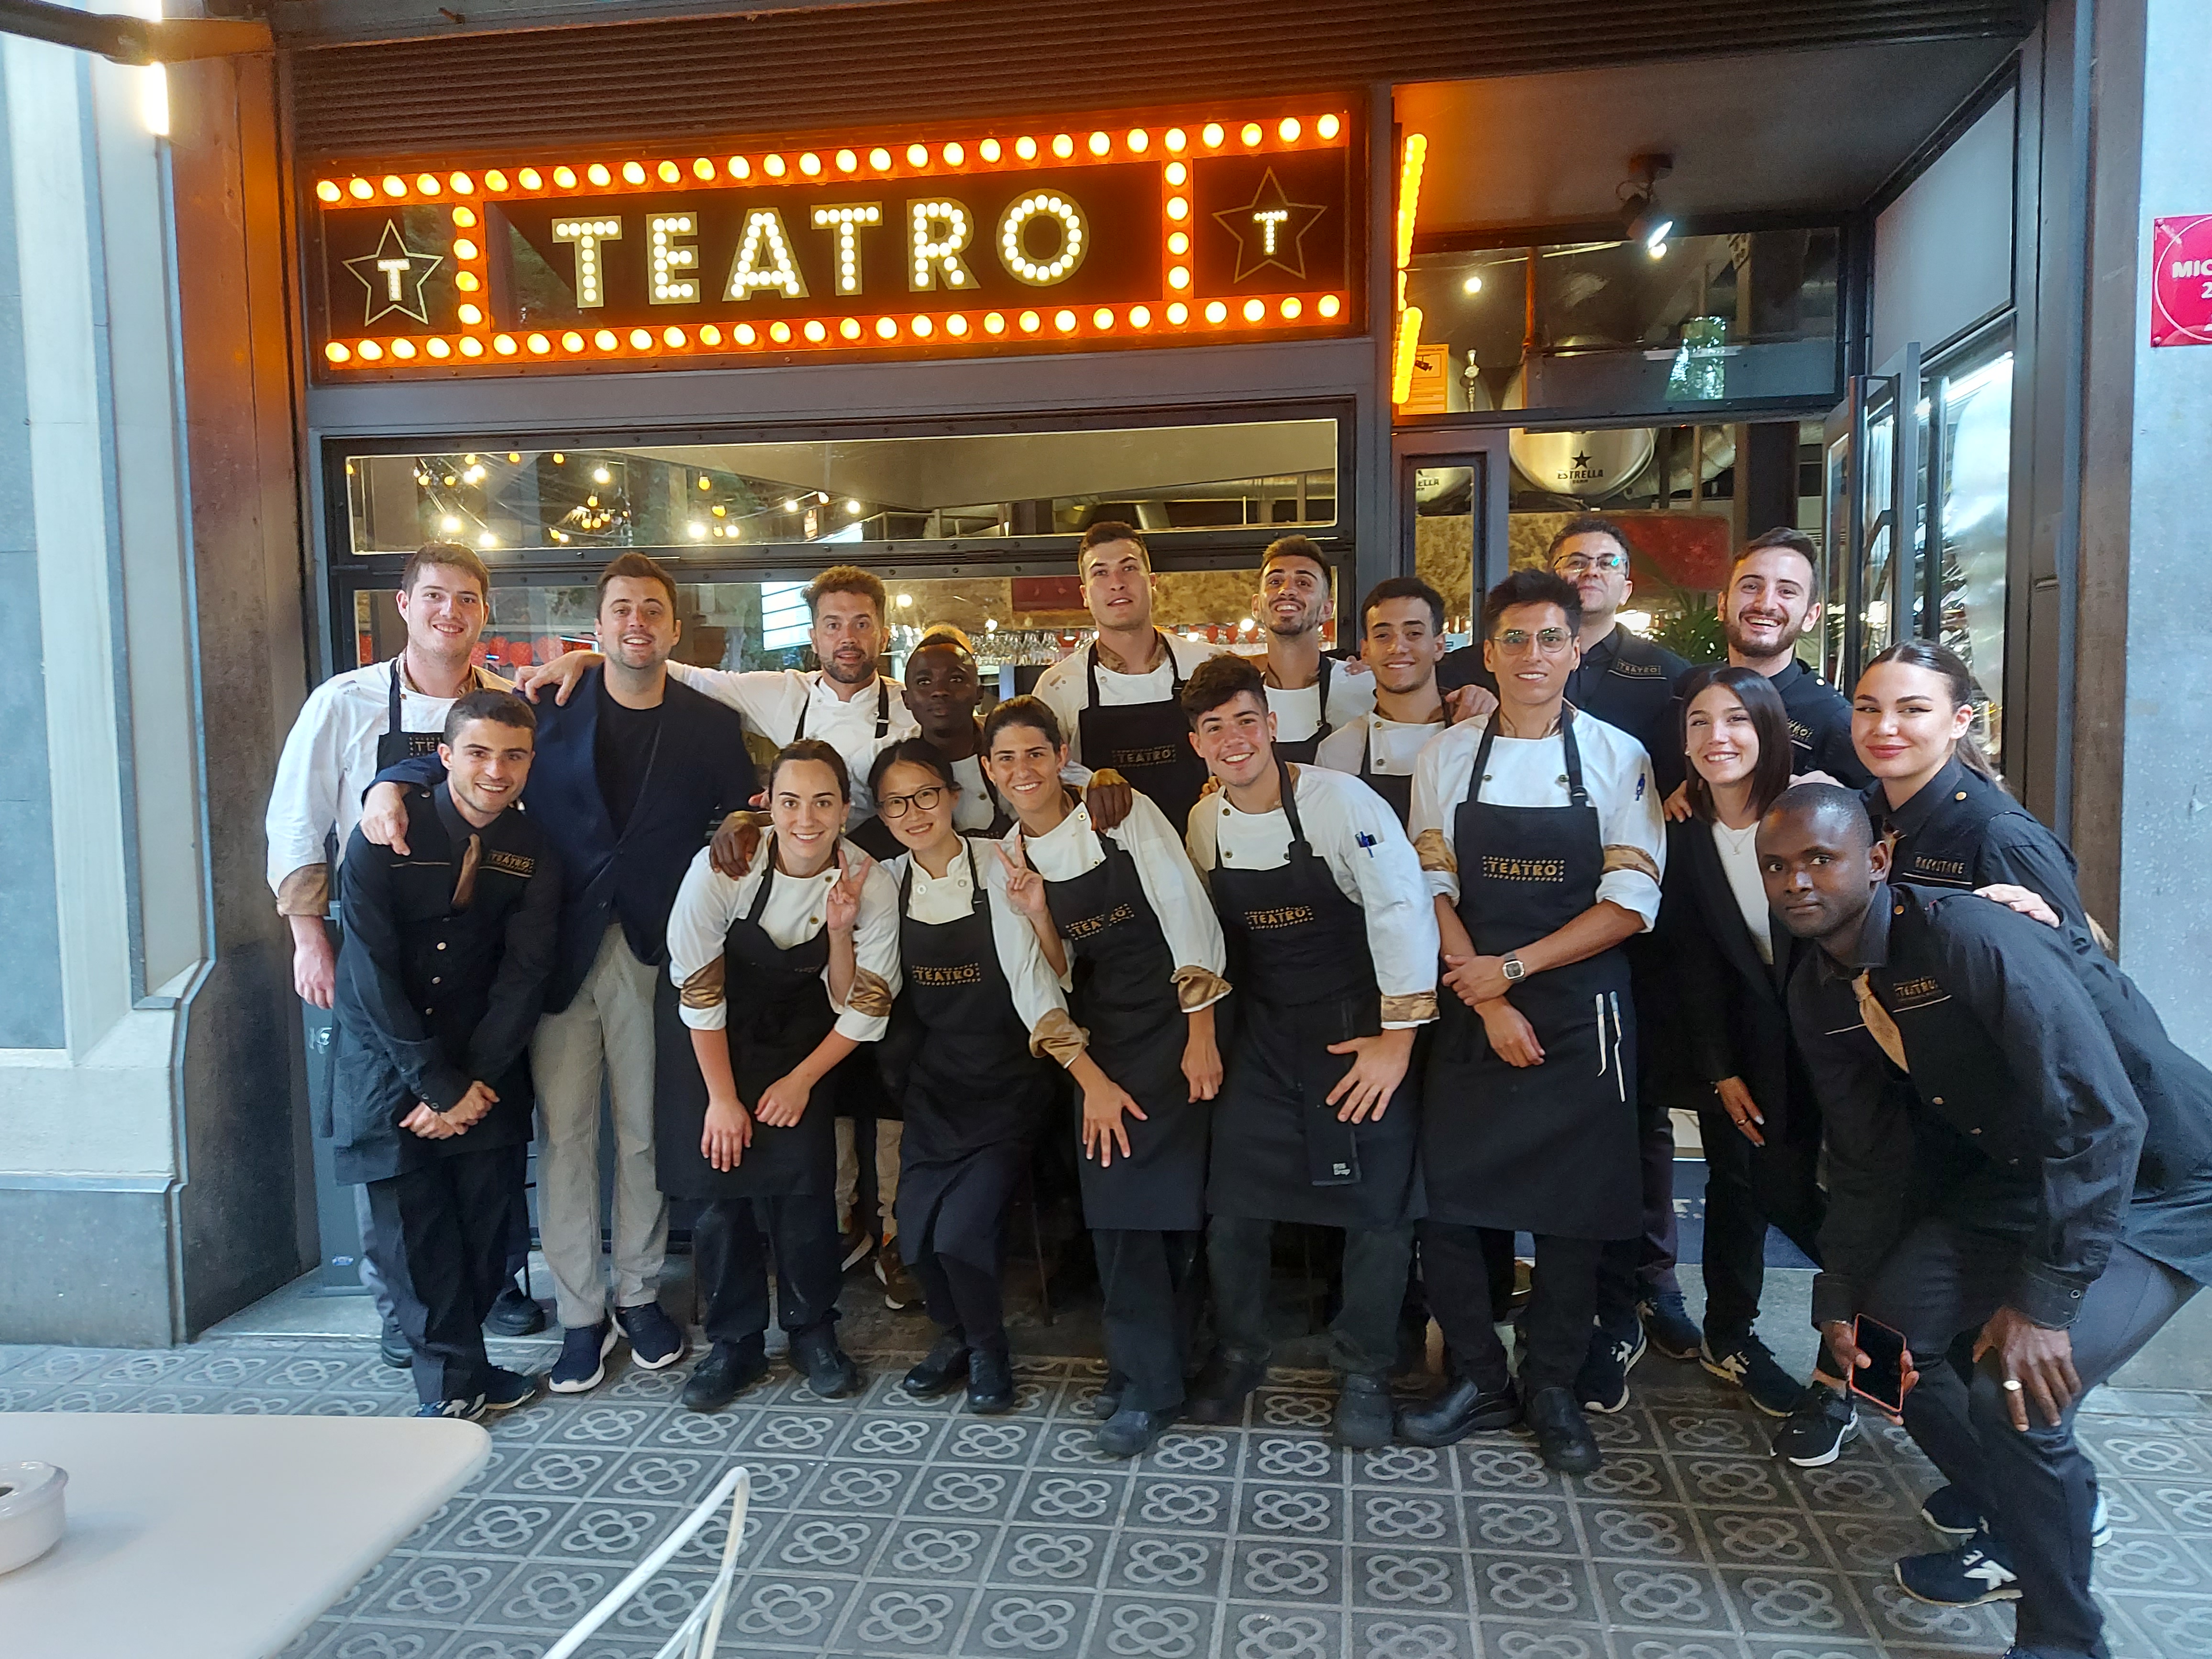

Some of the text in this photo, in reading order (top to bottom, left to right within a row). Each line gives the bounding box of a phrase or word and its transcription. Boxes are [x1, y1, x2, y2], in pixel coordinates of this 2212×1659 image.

[1252, 210, 1288, 255] T
[552, 188, 1090, 309] TEATRO
[2172, 259, 2212, 278] MIC
[377, 258, 410, 302] T
[1557, 469, 1604, 479] ESTRELLA
[1618, 662, 1658, 673] TEATRO
[414, 741, 435, 752] TE
[1117, 749, 1172, 763] TEATRO
[491, 852, 531, 868] TEATRO
[1487, 861, 1558, 876] TEATRO
[1072, 909, 1127, 935] TEAO
[1249, 910, 1306, 925] TEATRO
[913, 968, 974, 982] TEATRO
